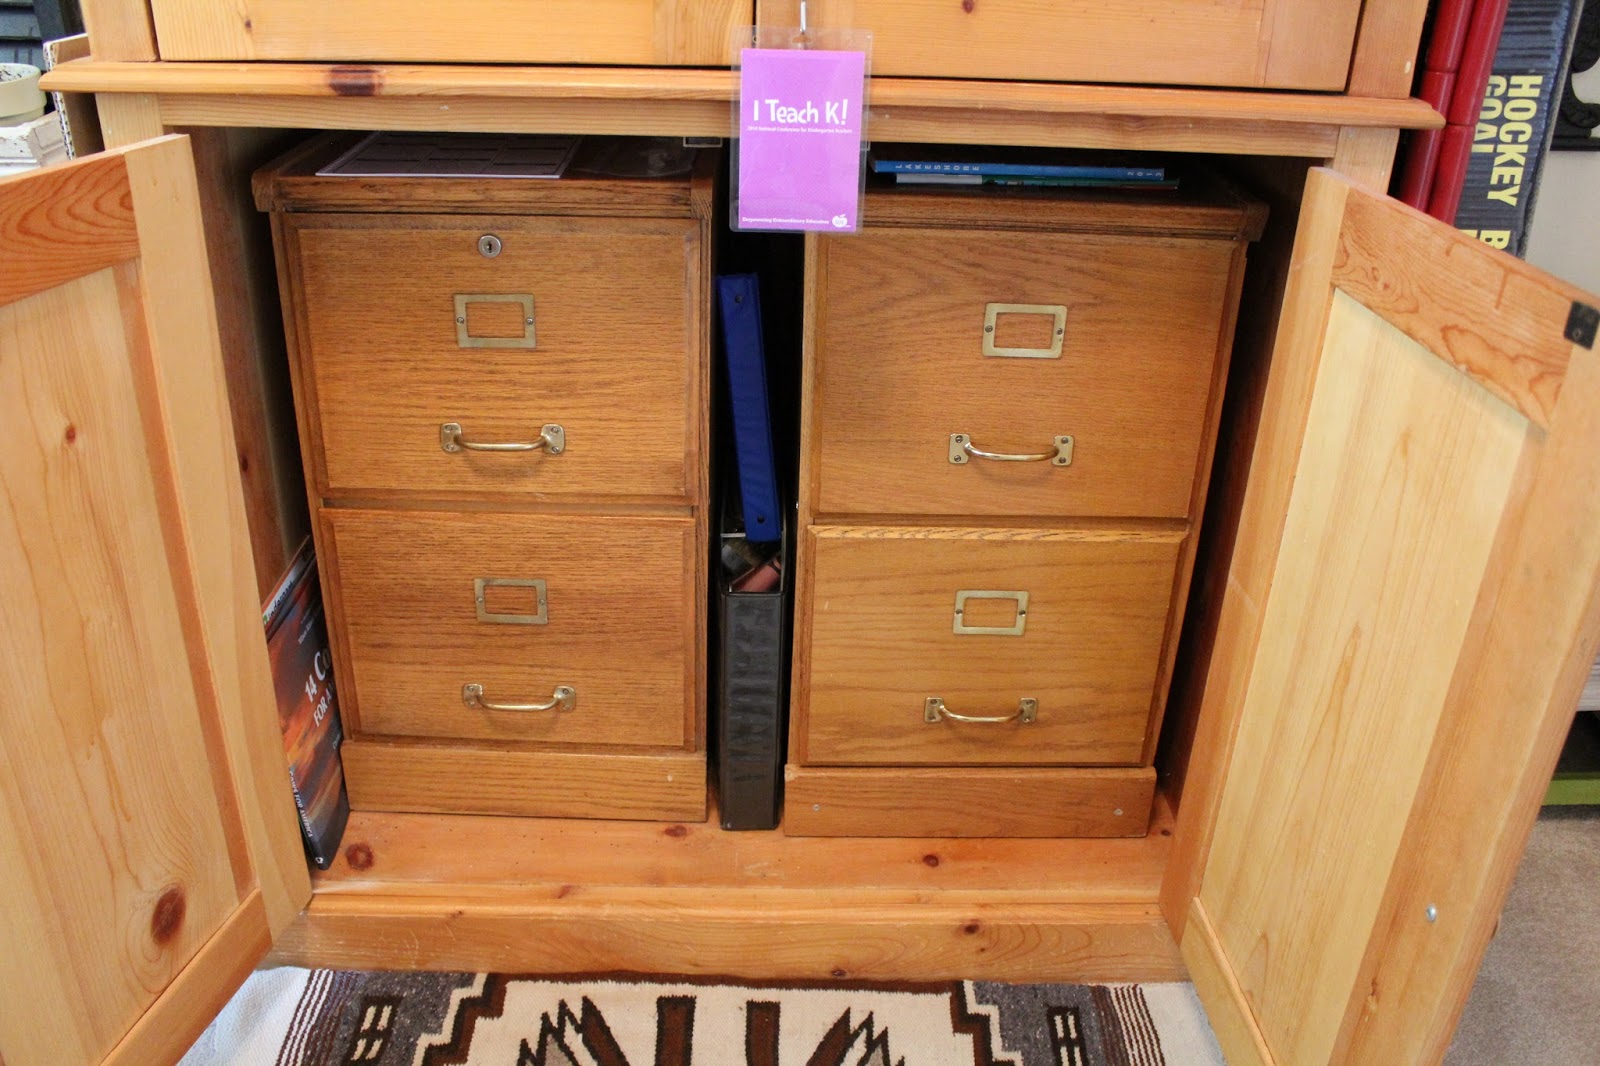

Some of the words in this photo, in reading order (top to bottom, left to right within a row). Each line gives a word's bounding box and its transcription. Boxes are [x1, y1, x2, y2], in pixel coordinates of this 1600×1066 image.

[753, 99, 759, 121] I
[765, 98, 819, 124] Teach
[825, 98, 849, 126] K!
[1487, 75, 1543, 207] HOCKEY
[895, 163, 980, 171] LAKESHORE
[304, 673, 318, 703] 14
[313, 695, 328, 728] FOR
[294, 793, 303, 808] FOR
[299, 808, 314, 838] AMERICA
